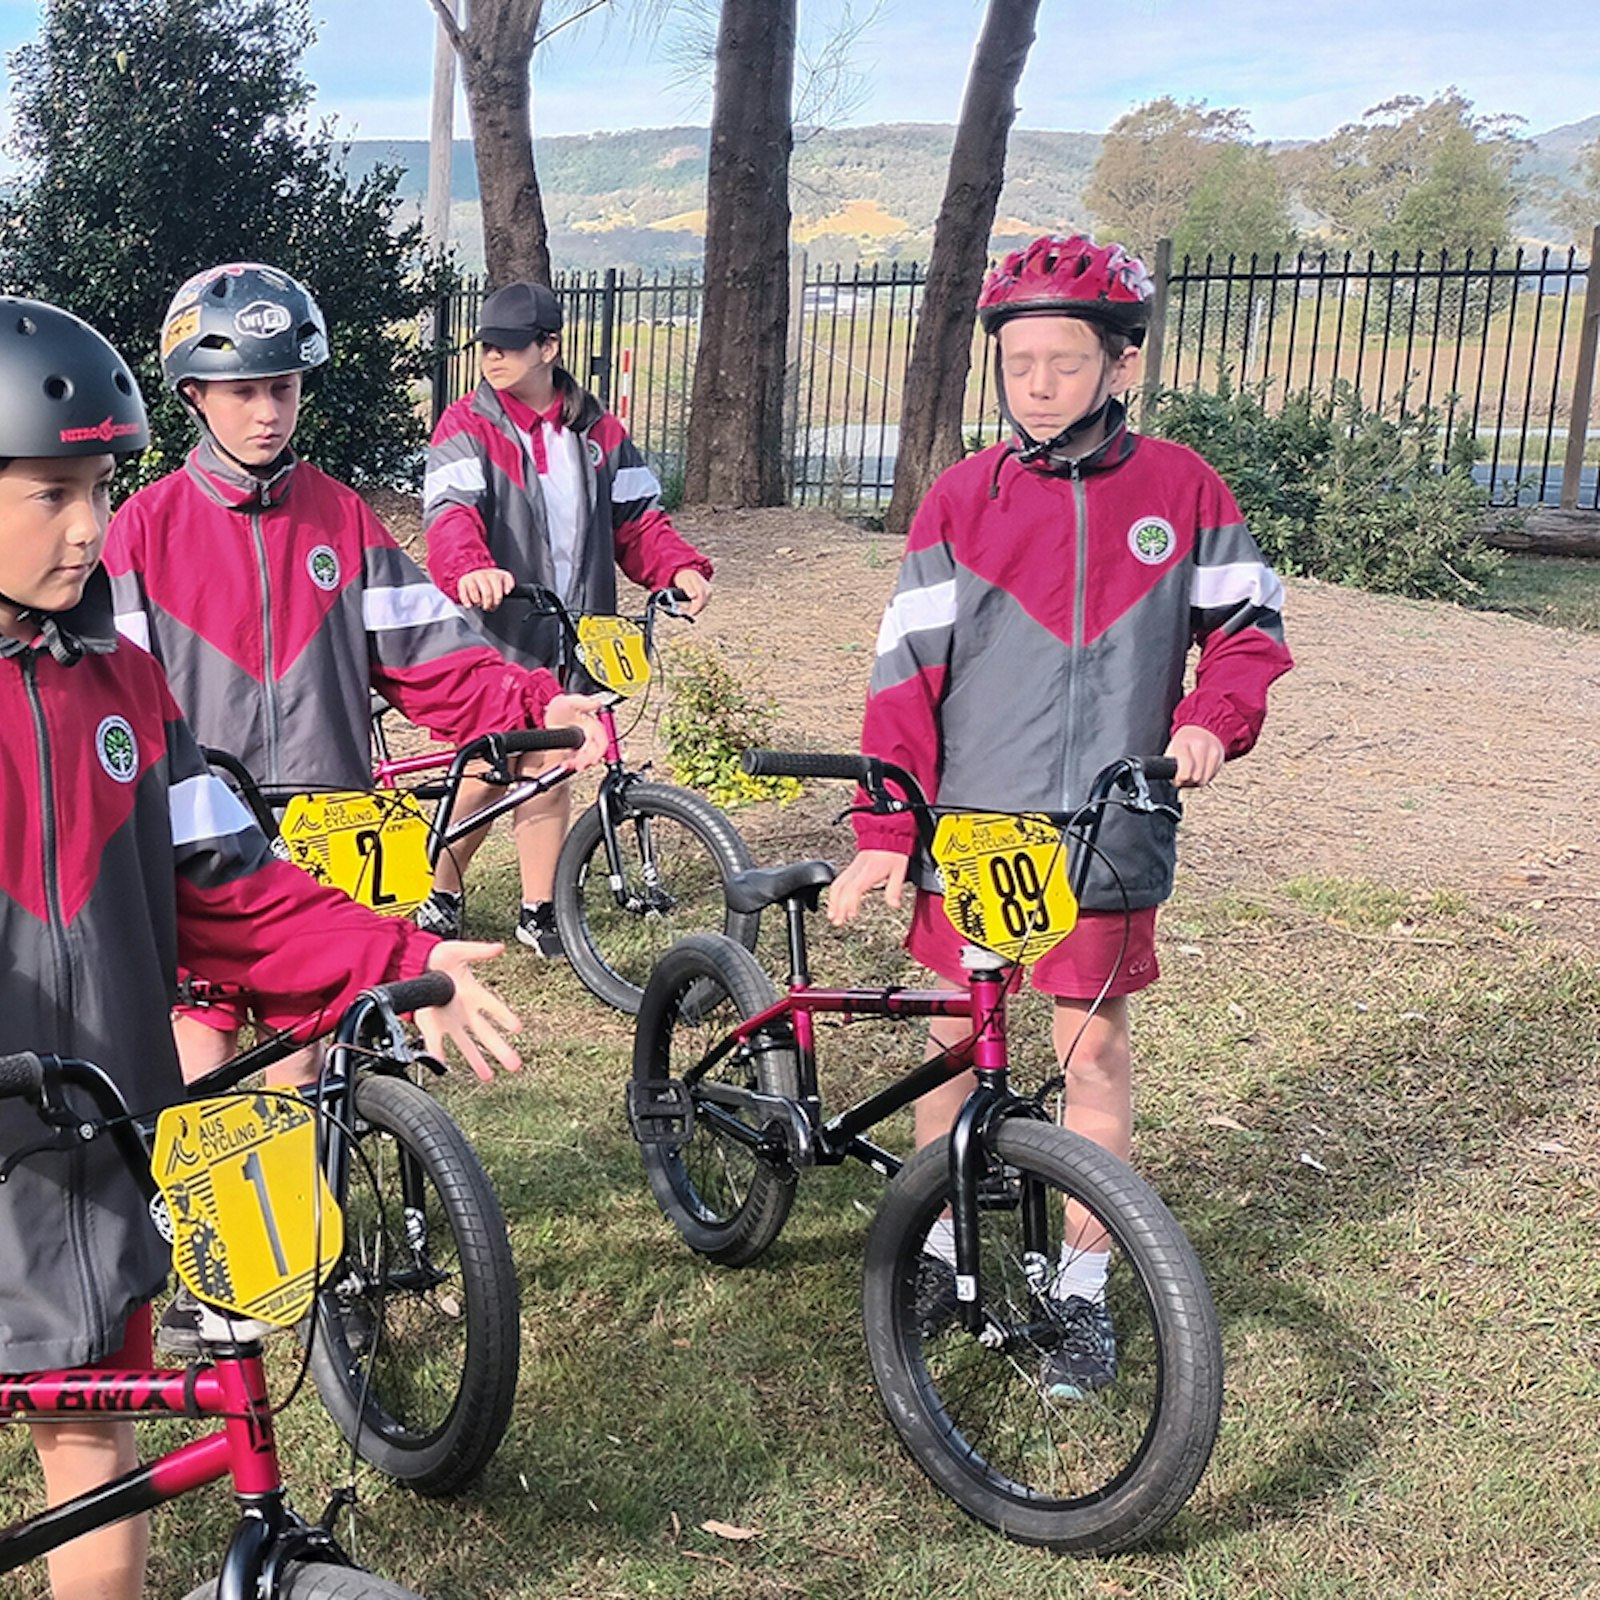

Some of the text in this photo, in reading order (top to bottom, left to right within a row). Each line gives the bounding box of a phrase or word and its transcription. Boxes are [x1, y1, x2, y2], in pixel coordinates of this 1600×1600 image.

[612, 638, 635, 682] 6
[323, 804, 347, 819] AUS
[324, 809, 373, 829] CYCLING
[971, 825, 992, 840] AUS
[972, 833, 1017, 851] CYCLING
[356, 830, 396, 905] 2
[990, 852, 1051, 938] 89
[199, 1117, 225, 1142] AUS
[202, 1122, 257, 1159] CYCLING
[242, 1151, 289, 1277] 1
[56, 1370, 184, 1411] BMX
